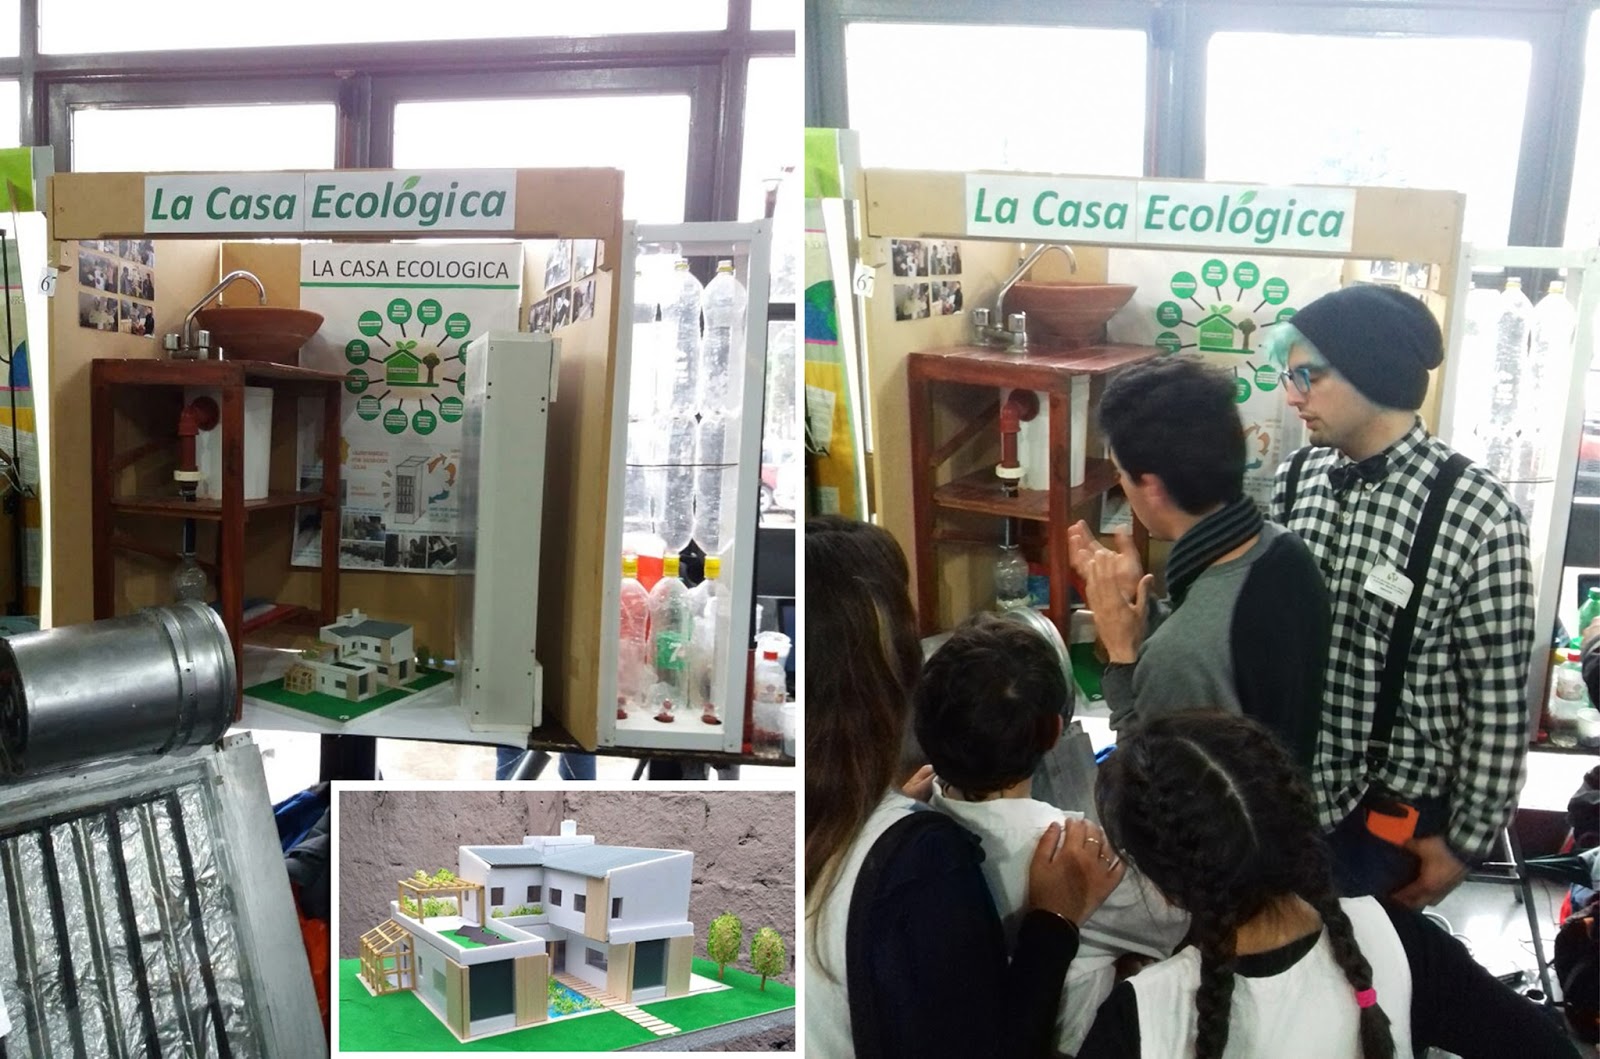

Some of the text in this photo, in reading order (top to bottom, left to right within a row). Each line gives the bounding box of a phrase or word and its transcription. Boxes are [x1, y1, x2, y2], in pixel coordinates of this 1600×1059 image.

[152, 176, 506, 227] La Casa Ecológica
[975, 188, 1344, 243] La Casa Ecológica
[312, 259, 509, 279] LA CASA ECOLOGICA
